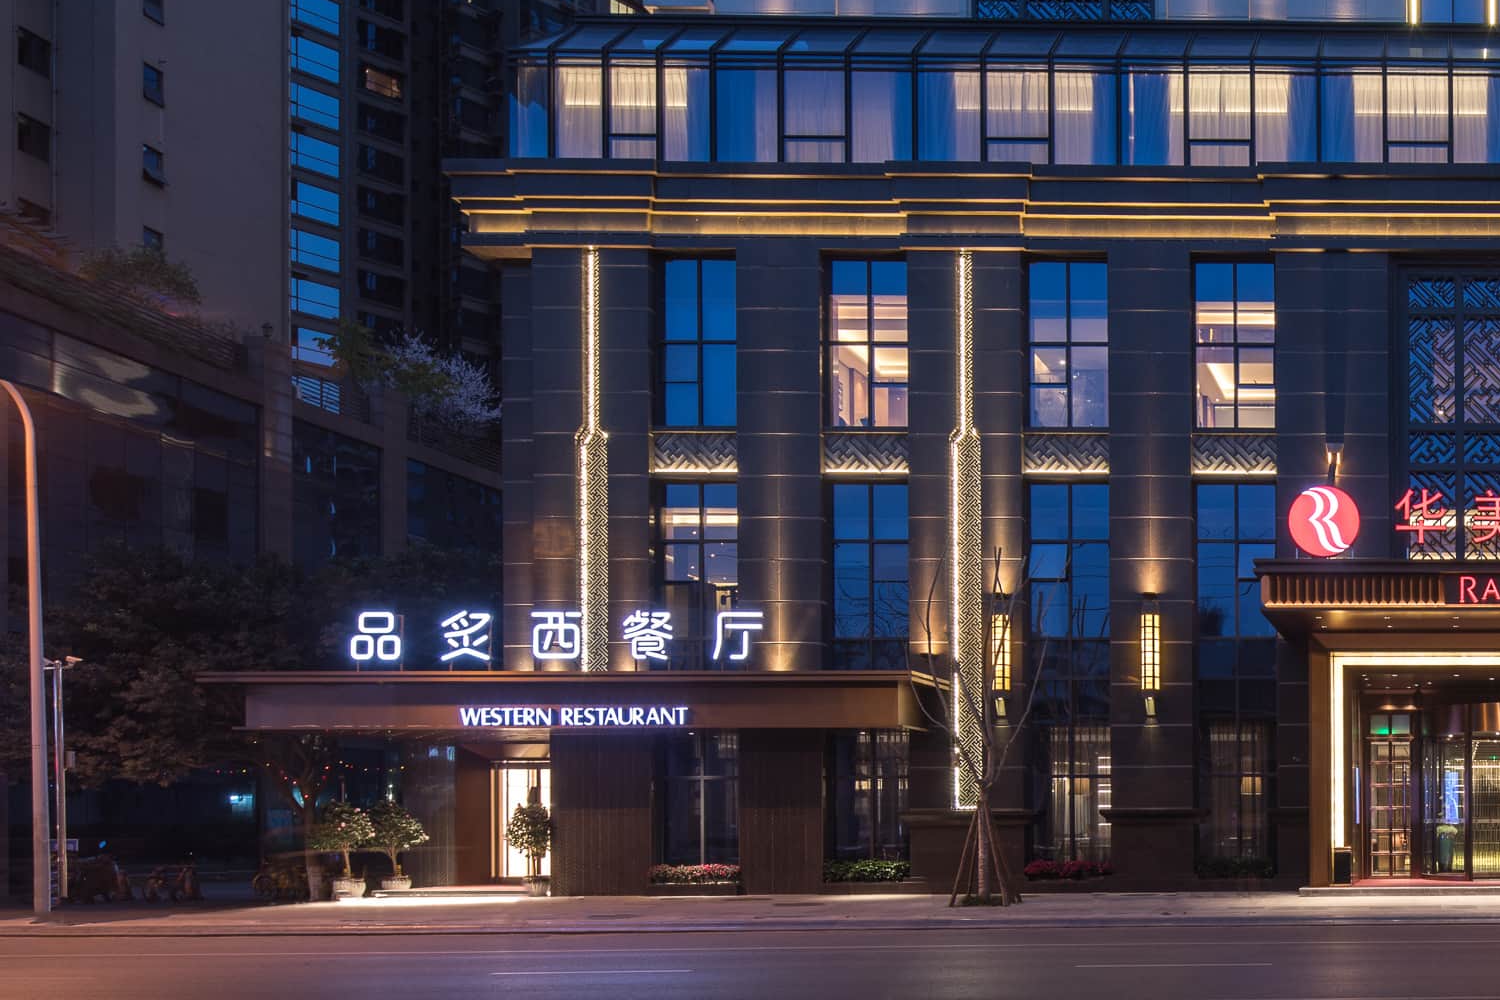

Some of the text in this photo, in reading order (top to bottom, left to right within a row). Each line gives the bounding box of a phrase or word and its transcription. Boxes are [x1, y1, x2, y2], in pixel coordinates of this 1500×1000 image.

[349, 609, 765, 662] 品炙西餐厅
[459, 706, 689, 727] WESTERN RESTAURANT
